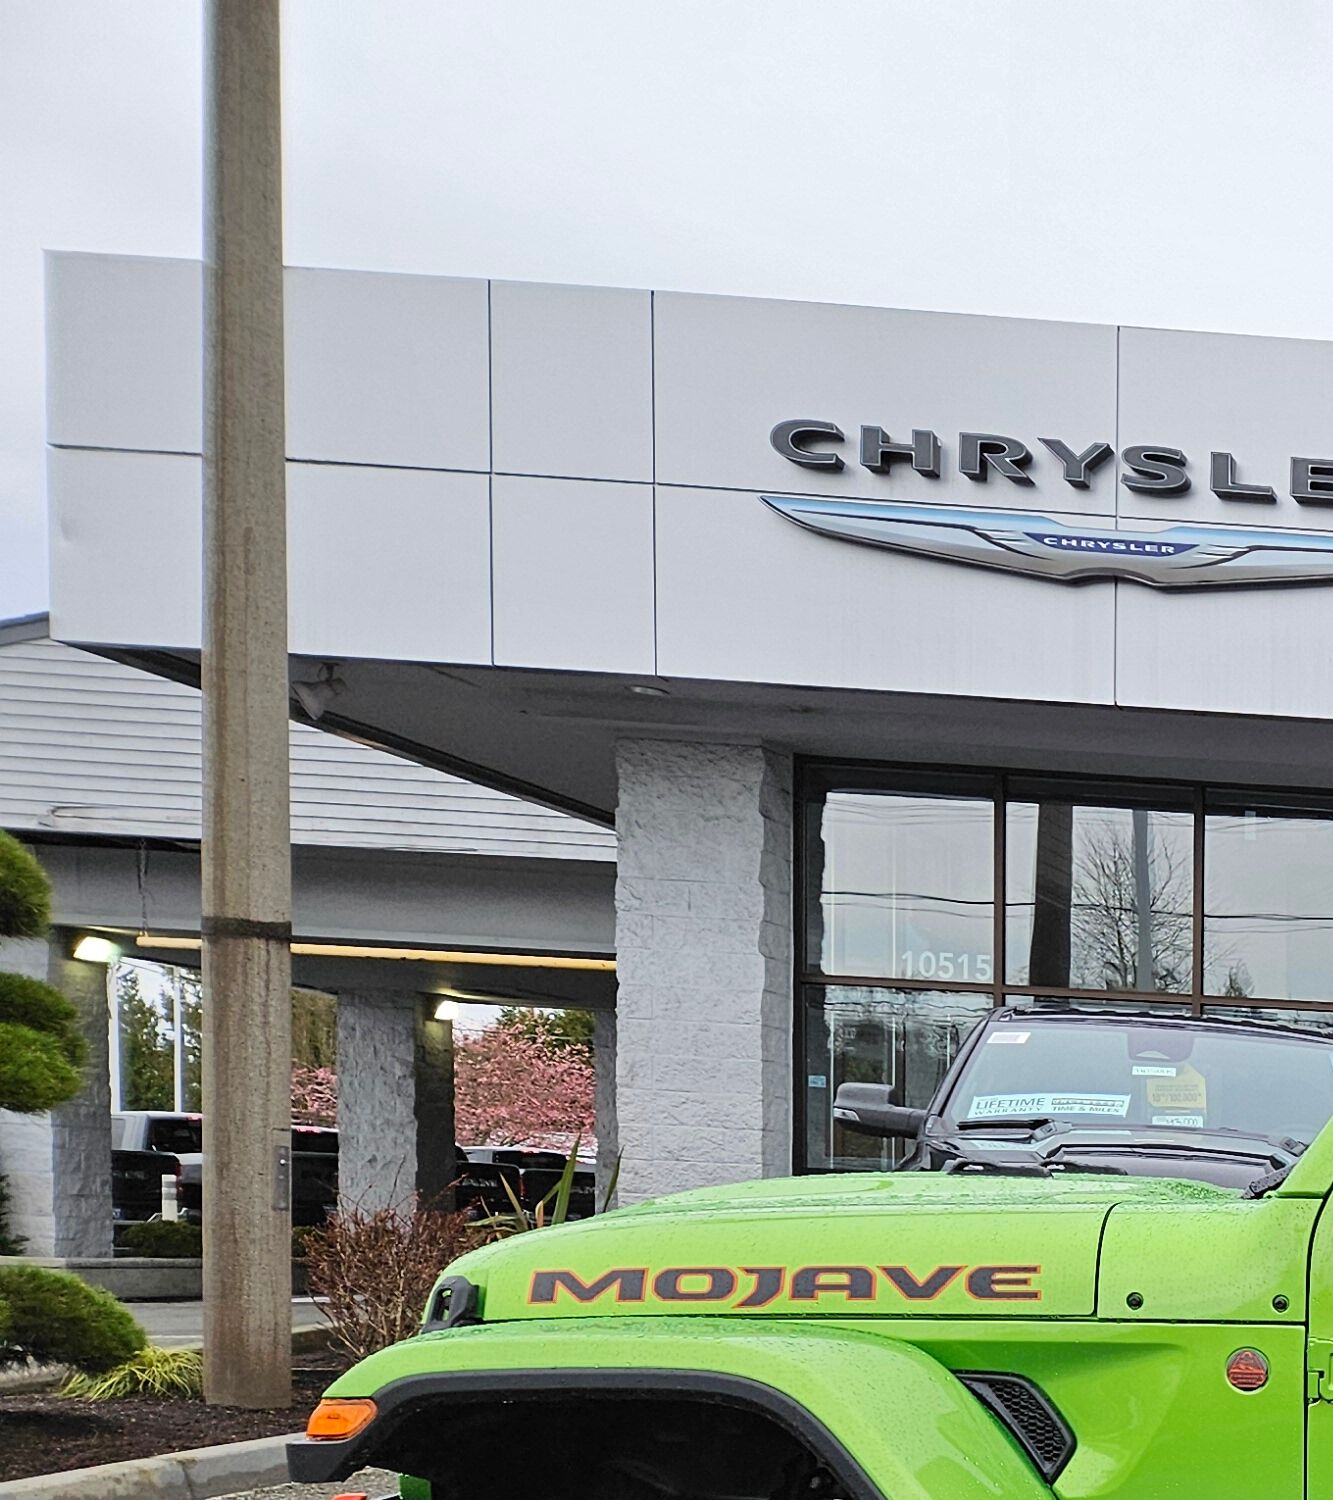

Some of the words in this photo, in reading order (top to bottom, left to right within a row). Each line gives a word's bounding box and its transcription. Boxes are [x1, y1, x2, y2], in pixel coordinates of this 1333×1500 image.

[1043, 537, 1175, 553] CHRYSLER
[902, 950, 992, 980] 10515
[975, 1097, 1046, 1110] LIFETIME
[527, 1264, 1042, 1309] MOJAVE
